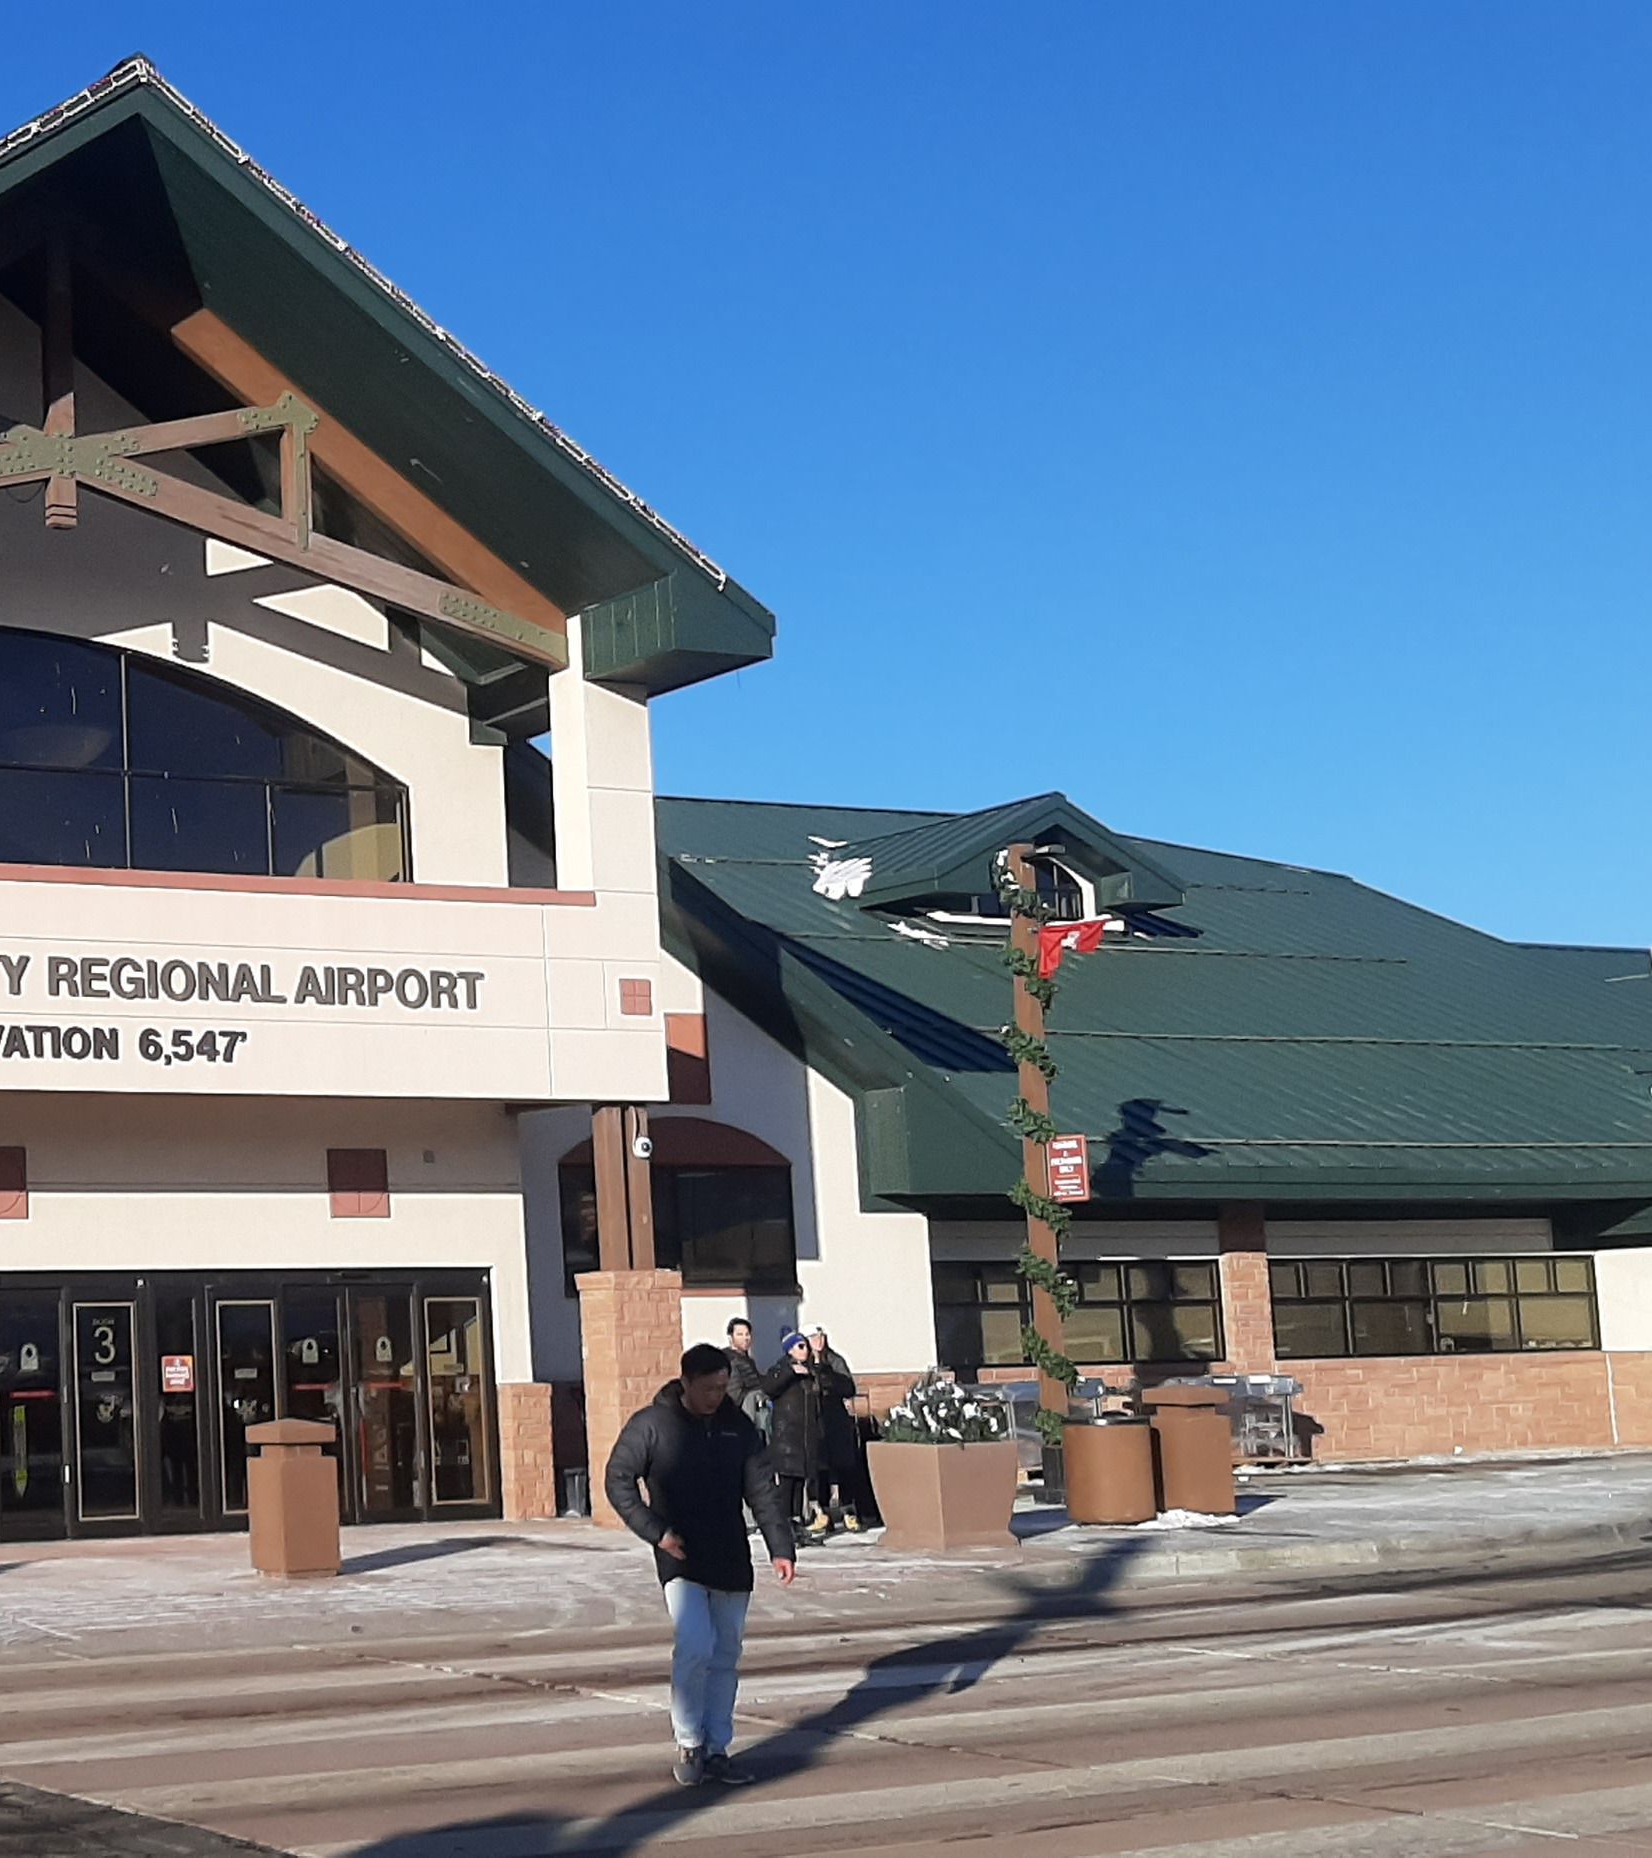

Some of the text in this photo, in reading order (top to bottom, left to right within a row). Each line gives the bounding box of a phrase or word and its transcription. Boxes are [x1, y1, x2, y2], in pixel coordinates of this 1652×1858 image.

[47, 955, 288, 1004] REGIONAL
[294, 964, 485, 1011] AIRPORT
[92, 1326, 116, 1364] 3
